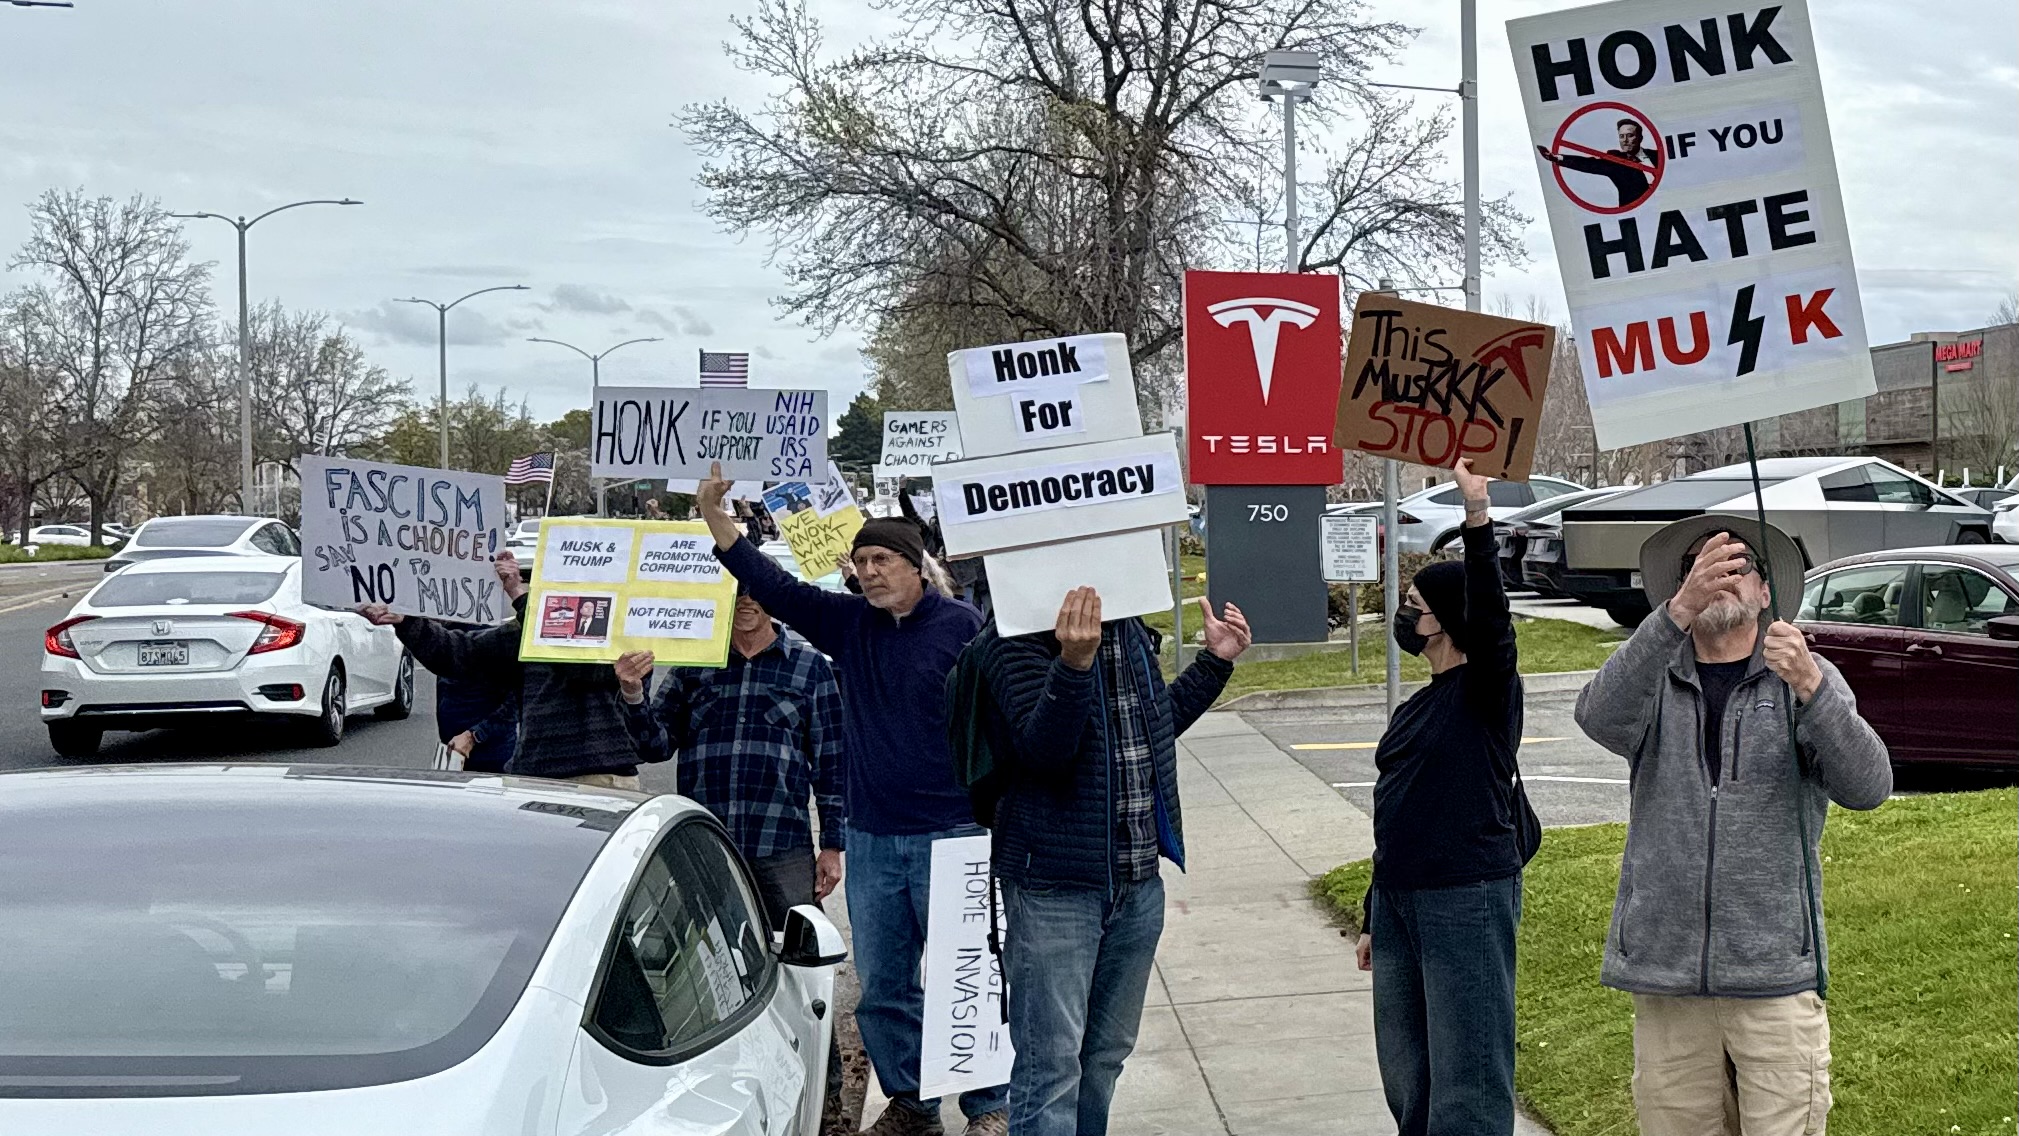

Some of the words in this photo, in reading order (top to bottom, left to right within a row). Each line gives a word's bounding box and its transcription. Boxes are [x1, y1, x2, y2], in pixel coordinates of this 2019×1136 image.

[1530, 5, 1794, 102] HONK
[1665, 131, 1697, 160] IF
[1708, 118, 1784, 153] YOU
[1583, 190, 1817, 279] HATE
[1959, 340, 1981, 358] MART
[991, 342, 1081, 383] Honk
[775, 390, 815, 414] NIH
[702, 409, 721, 431] IF
[727, 411, 756, 434] YOU
[766, 414, 820, 436] USAID
[888, 420, 947, 434] GAMERS
[1020, 399, 1073, 433] For
[595, 399, 690, 466] HONK
[888, 436, 945, 448] AGAINST
[697, 435, 763, 461] SUPPORT
[780, 436, 808, 458] IRS
[1201, 436, 1327, 453] TESLA
[771, 457, 812, 477] SSA
[884, 453, 940, 466] CHAOTIC
[325, 468, 485, 531] FASCISM
[962, 463, 1155, 515] Democracy
[781, 510, 815, 533] WE
[1247, 504, 1289, 522] 750
[378, 519, 393, 547] A
[397, 525, 497, 562] CHOICE!
[788, 516, 832, 549] KNOW
[794, 522, 848, 558] WHAT
[560, 541, 604, 552] MUSK
[606, 542, 616, 553] &
[670, 540, 697, 549] ARE
[409, 558, 431, 575] TO
[562, 555, 613, 567] TRUMP
[644, 551, 718, 562] PROMOTING
[800, 549, 838, 576] THIS
[640, 563, 720, 574] CORRUPTION
[417, 577, 495, 622] MUSK
[628, 607, 655, 617] NOT
[656, 608, 715, 618] FIGHTING
[648, 620, 693, 630] WASTE
[962, 861, 988, 923] HOME
[949, 947, 983, 1073] INVASION
